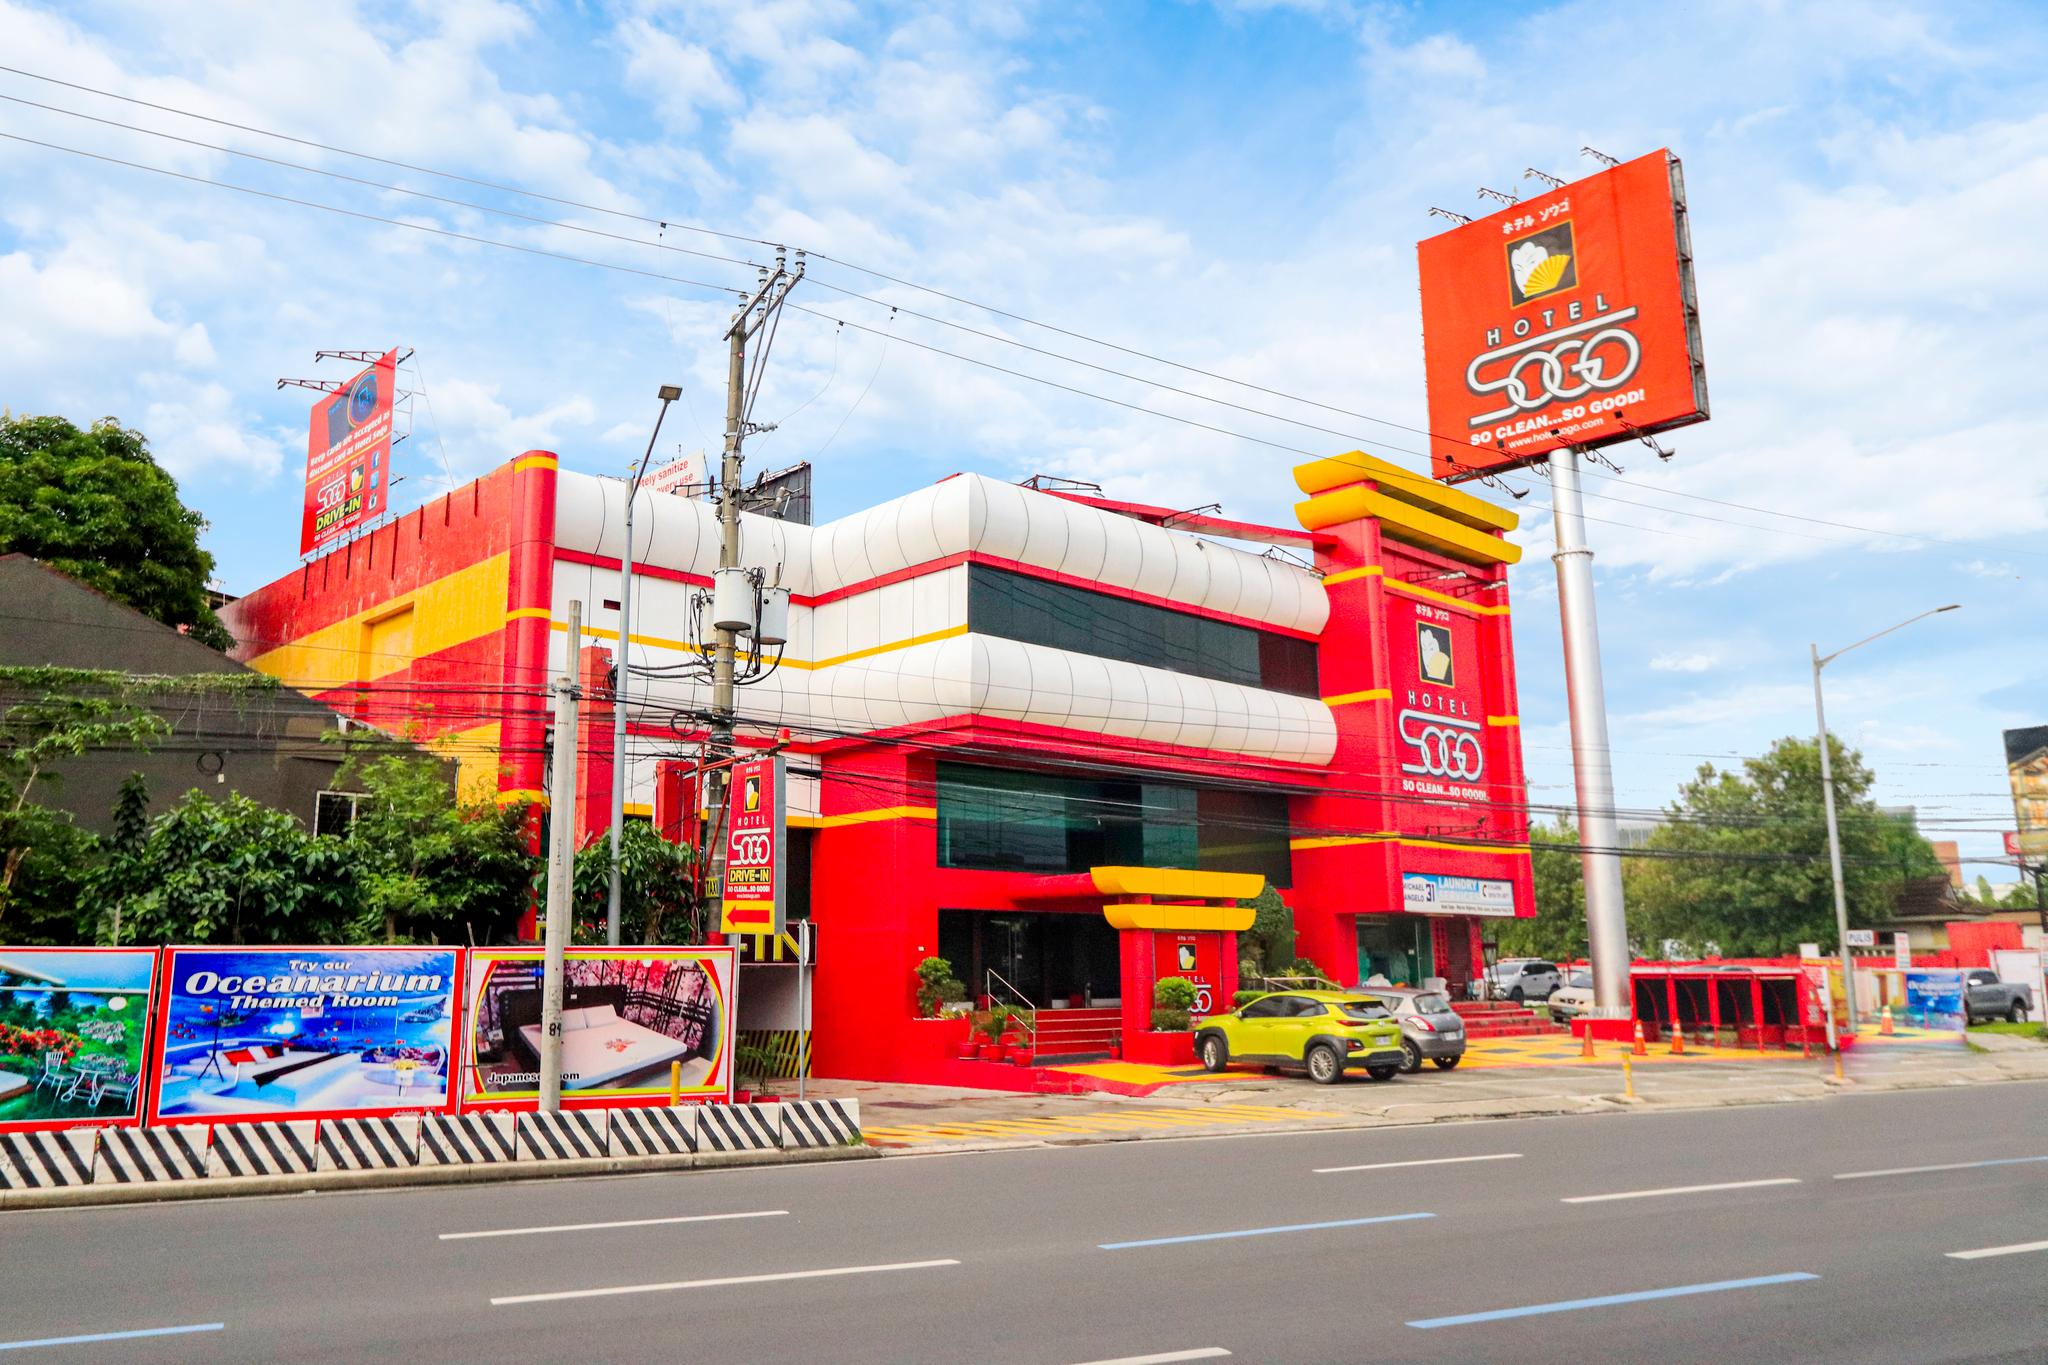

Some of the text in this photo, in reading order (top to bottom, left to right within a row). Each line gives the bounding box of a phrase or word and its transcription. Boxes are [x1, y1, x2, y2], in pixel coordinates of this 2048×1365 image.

[1502, 214, 1535, 235] ホテル
[1486, 293, 1609, 347] HOTEL
[1466, 306, 1640, 427] SOGO
[353, 413, 382, 440] accepted
[1470, 431, 1491, 446] SO
[1589, 389, 1645, 414] GOOD!
[640, 459, 689, 488] tely sanitize
[679, 472, 694, 487] use
[316, 473, 347, 515] SOGO
[315, 494, 362, 532] DRIVE-IN
[1408, 690, 1469, 716] HOTEL
[1399, 708, 1483, 783] SOGO
[1402, 779, 1415, 792] SO
[737, 815, 765, 827] HOTEL
[729, 827, 771, 865] SOGO
[730, 869, 769, 882] DRIVE-IN
[1425, 883, 1435, 902] 31
[288, 960, 353, 972] Try our
[185, 970, 442, 995] Oceanarium
[1180, 975, 1205, 983] OTEL
[230, 994, 399, 1010] Themed Room
[487, 1071, 540, 1086] Japanes
